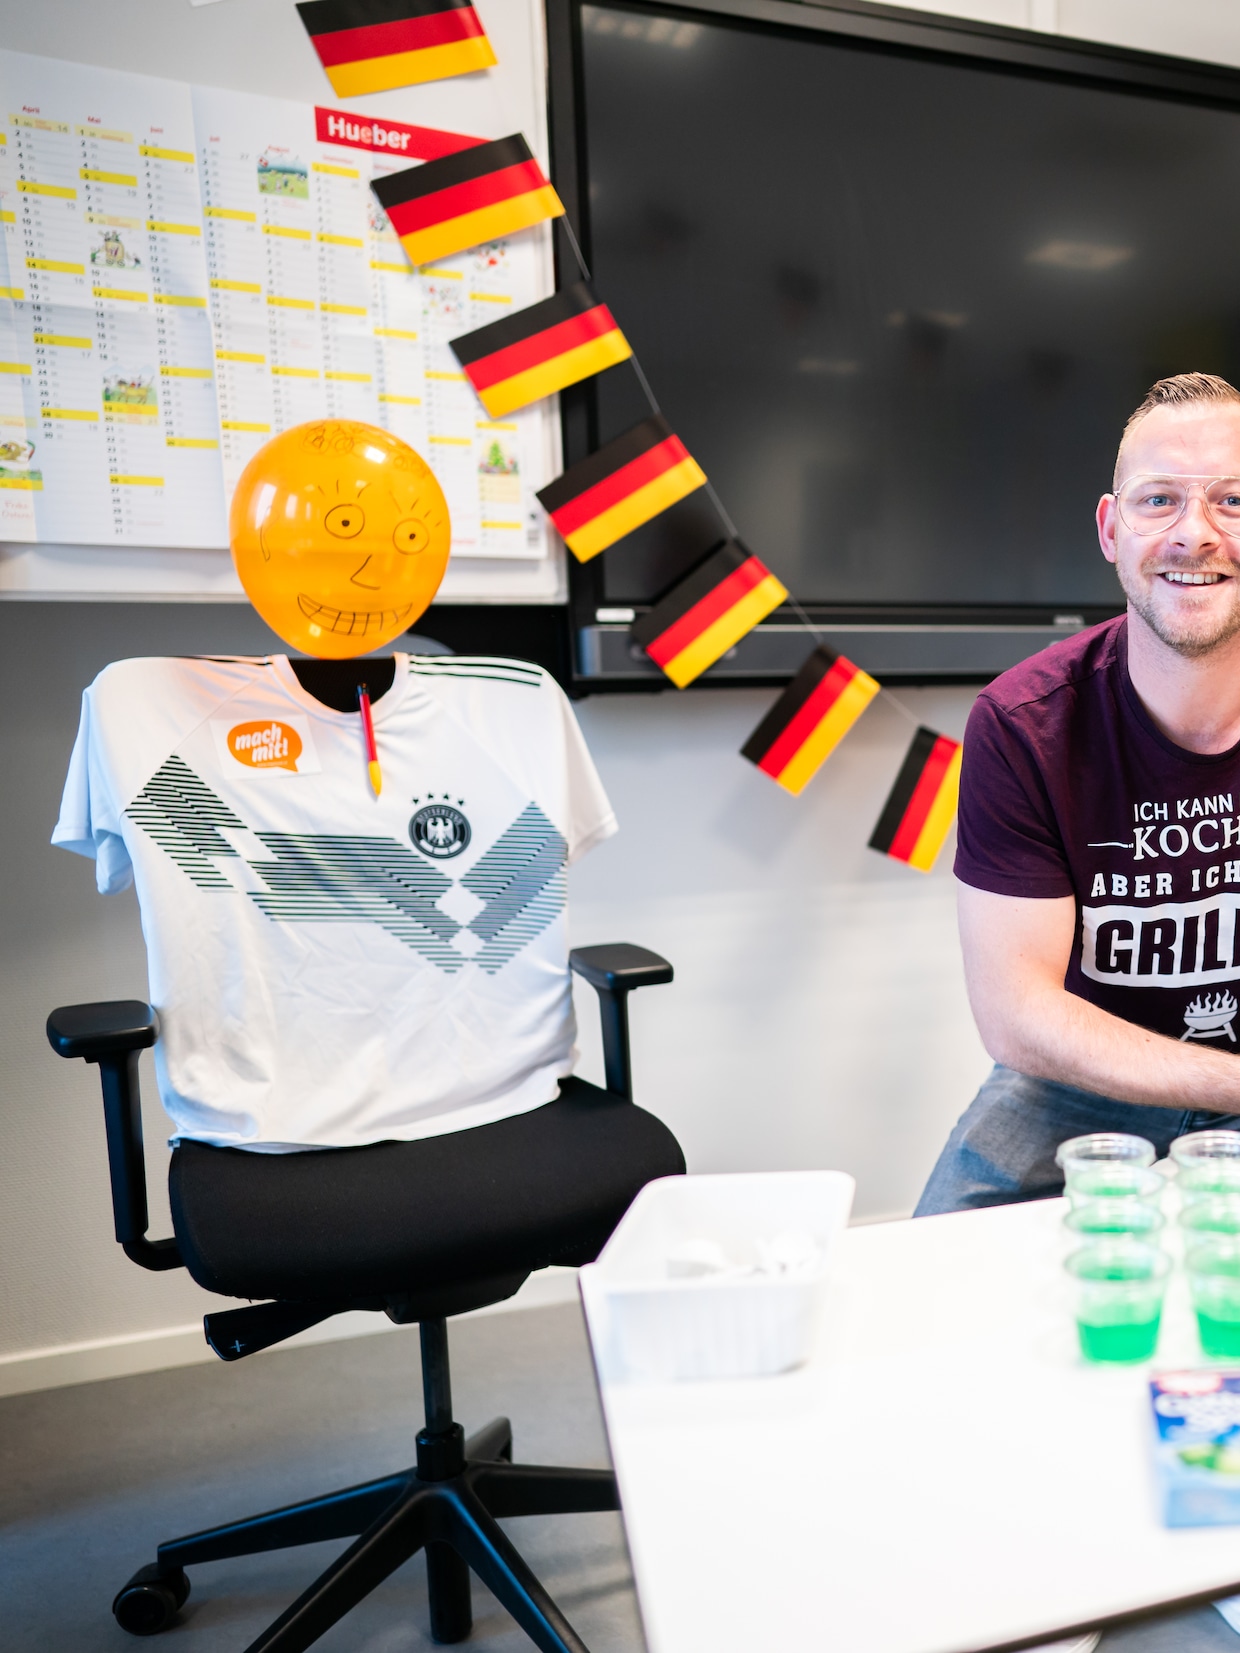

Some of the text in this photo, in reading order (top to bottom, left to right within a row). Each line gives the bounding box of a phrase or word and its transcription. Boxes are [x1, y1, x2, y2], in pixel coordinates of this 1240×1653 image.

[328, 115, 411, 150] Hueber
[235, 722, 282, 751] mach
[252, 737, 288, 763] mit!
[1134, 802, 1168, 822] ICH
[1176, 793, 1233, 819] KANN
[1090, 872, 1173, 898] ABER
